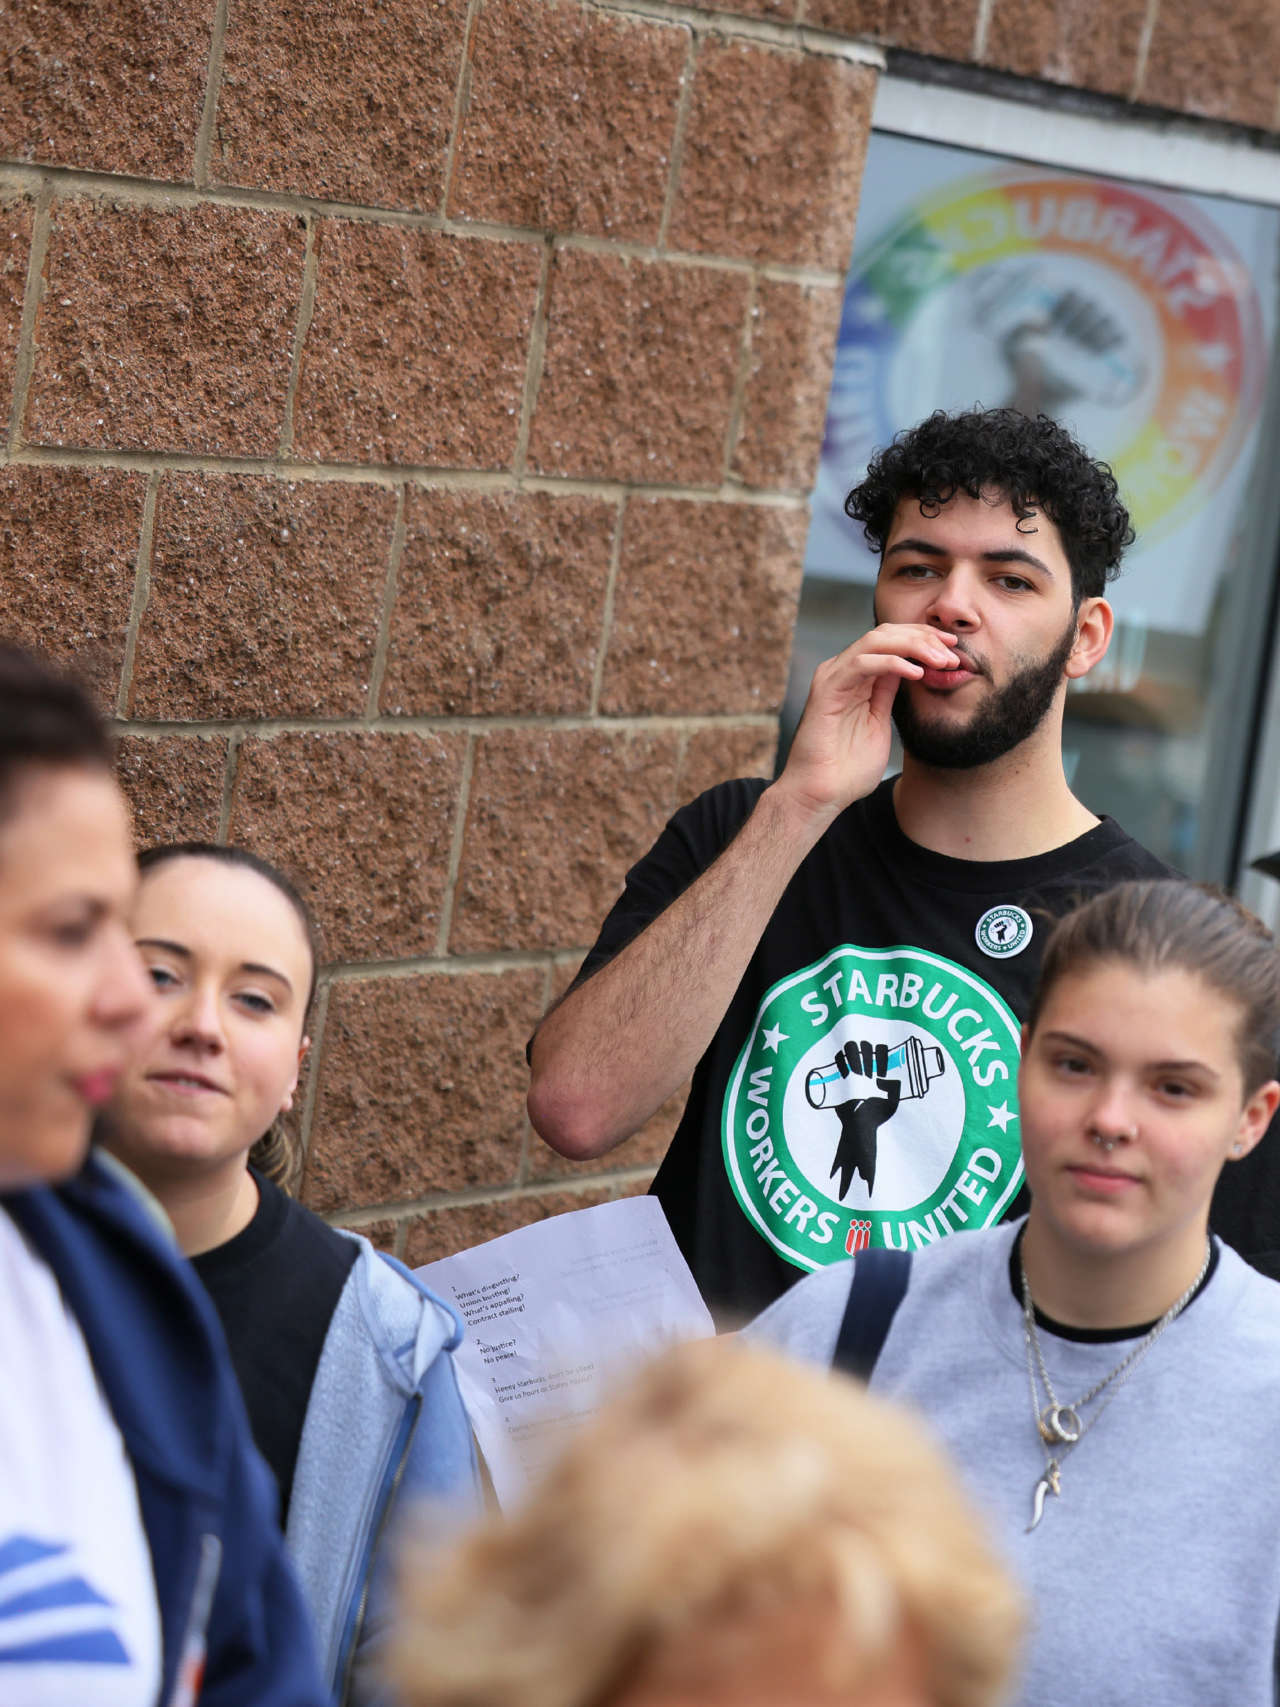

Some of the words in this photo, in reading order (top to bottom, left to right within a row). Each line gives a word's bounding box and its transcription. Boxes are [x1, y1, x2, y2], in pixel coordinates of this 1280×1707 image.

[987, 910, 1022, 923] STARBUCKS
[800, 969, 1009, 1087] STARBUCKS
[745, 1065, 841, 1244] WORKERS
[881, 1147, 1003, 1252] UNITED
[455, 1288, 481, 1301] What's
[481, 1273, 520, 1293] disgusting?
[460, 1298, 482, 1309] Union
[482, 1287, 511, 1302] busting!
[464, 1304, 489, 1318] What's
[490, 1293, 525, 1310] appalling?
[467, 1312, 498, 1327] Contract
[499, 1303, 526, 1317] stalling!
